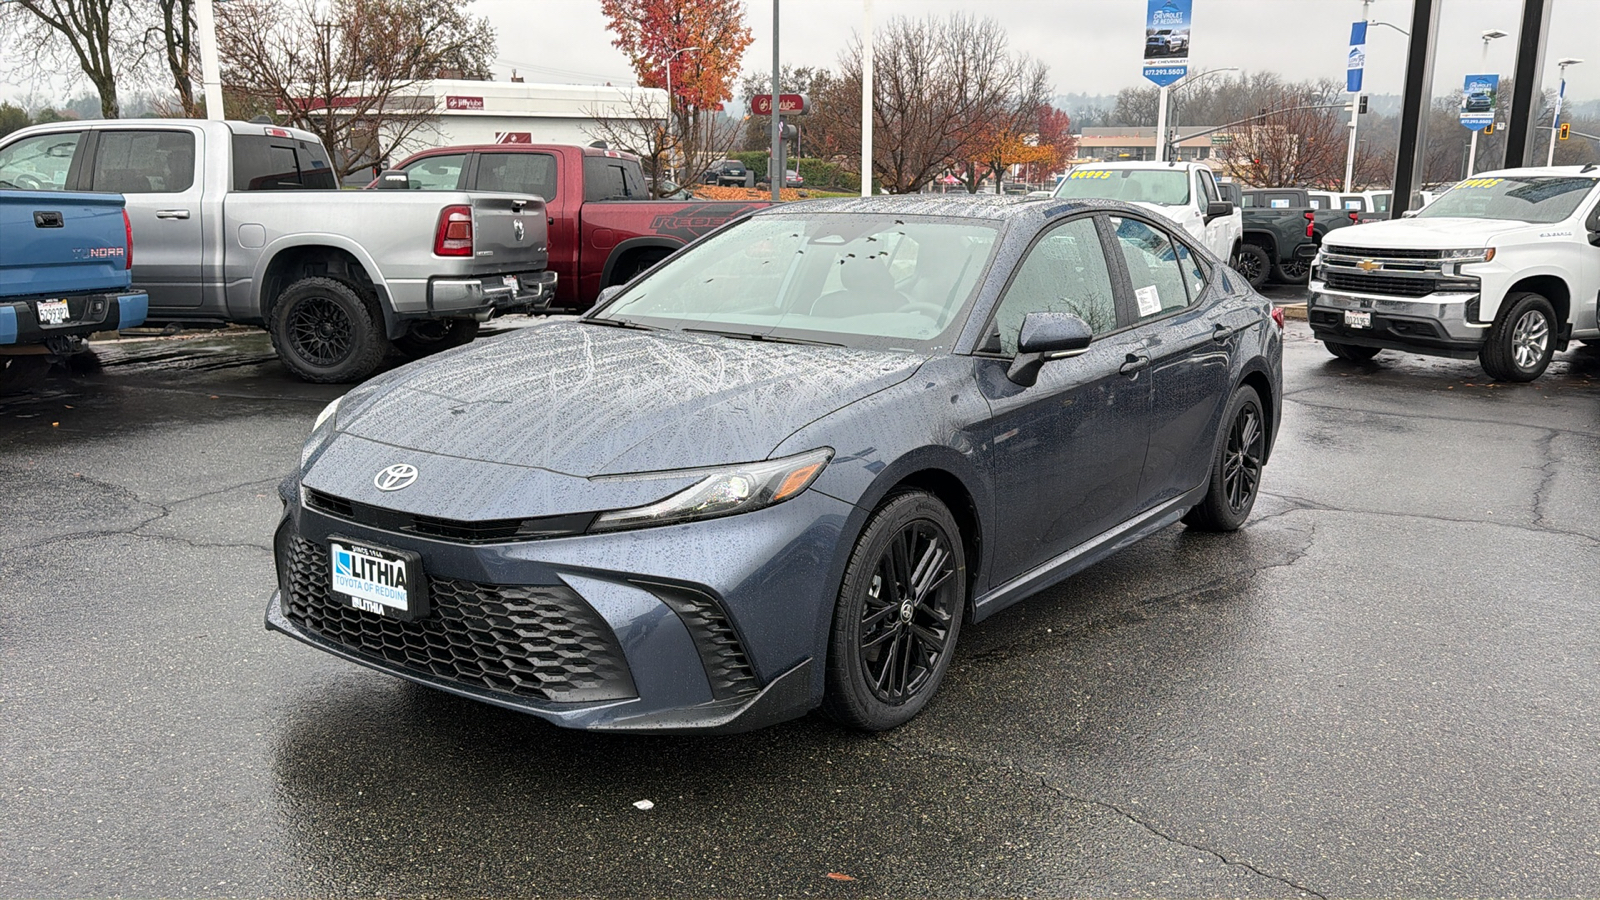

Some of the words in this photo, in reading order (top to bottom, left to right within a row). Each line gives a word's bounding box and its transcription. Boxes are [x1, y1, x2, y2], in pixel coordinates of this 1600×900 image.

[1154, 12, 1183, 20] CHEVROLET
[1161, 17, 1183, 25] REDDING
[351, 545, 369, 555] SINCE
[352, 555, 407, 588] LITHIA
[335, 575, 363, 590] TOYOTA
[363, 582, 374, 594] OF
[359, 599, 385, 616] LITHIA
